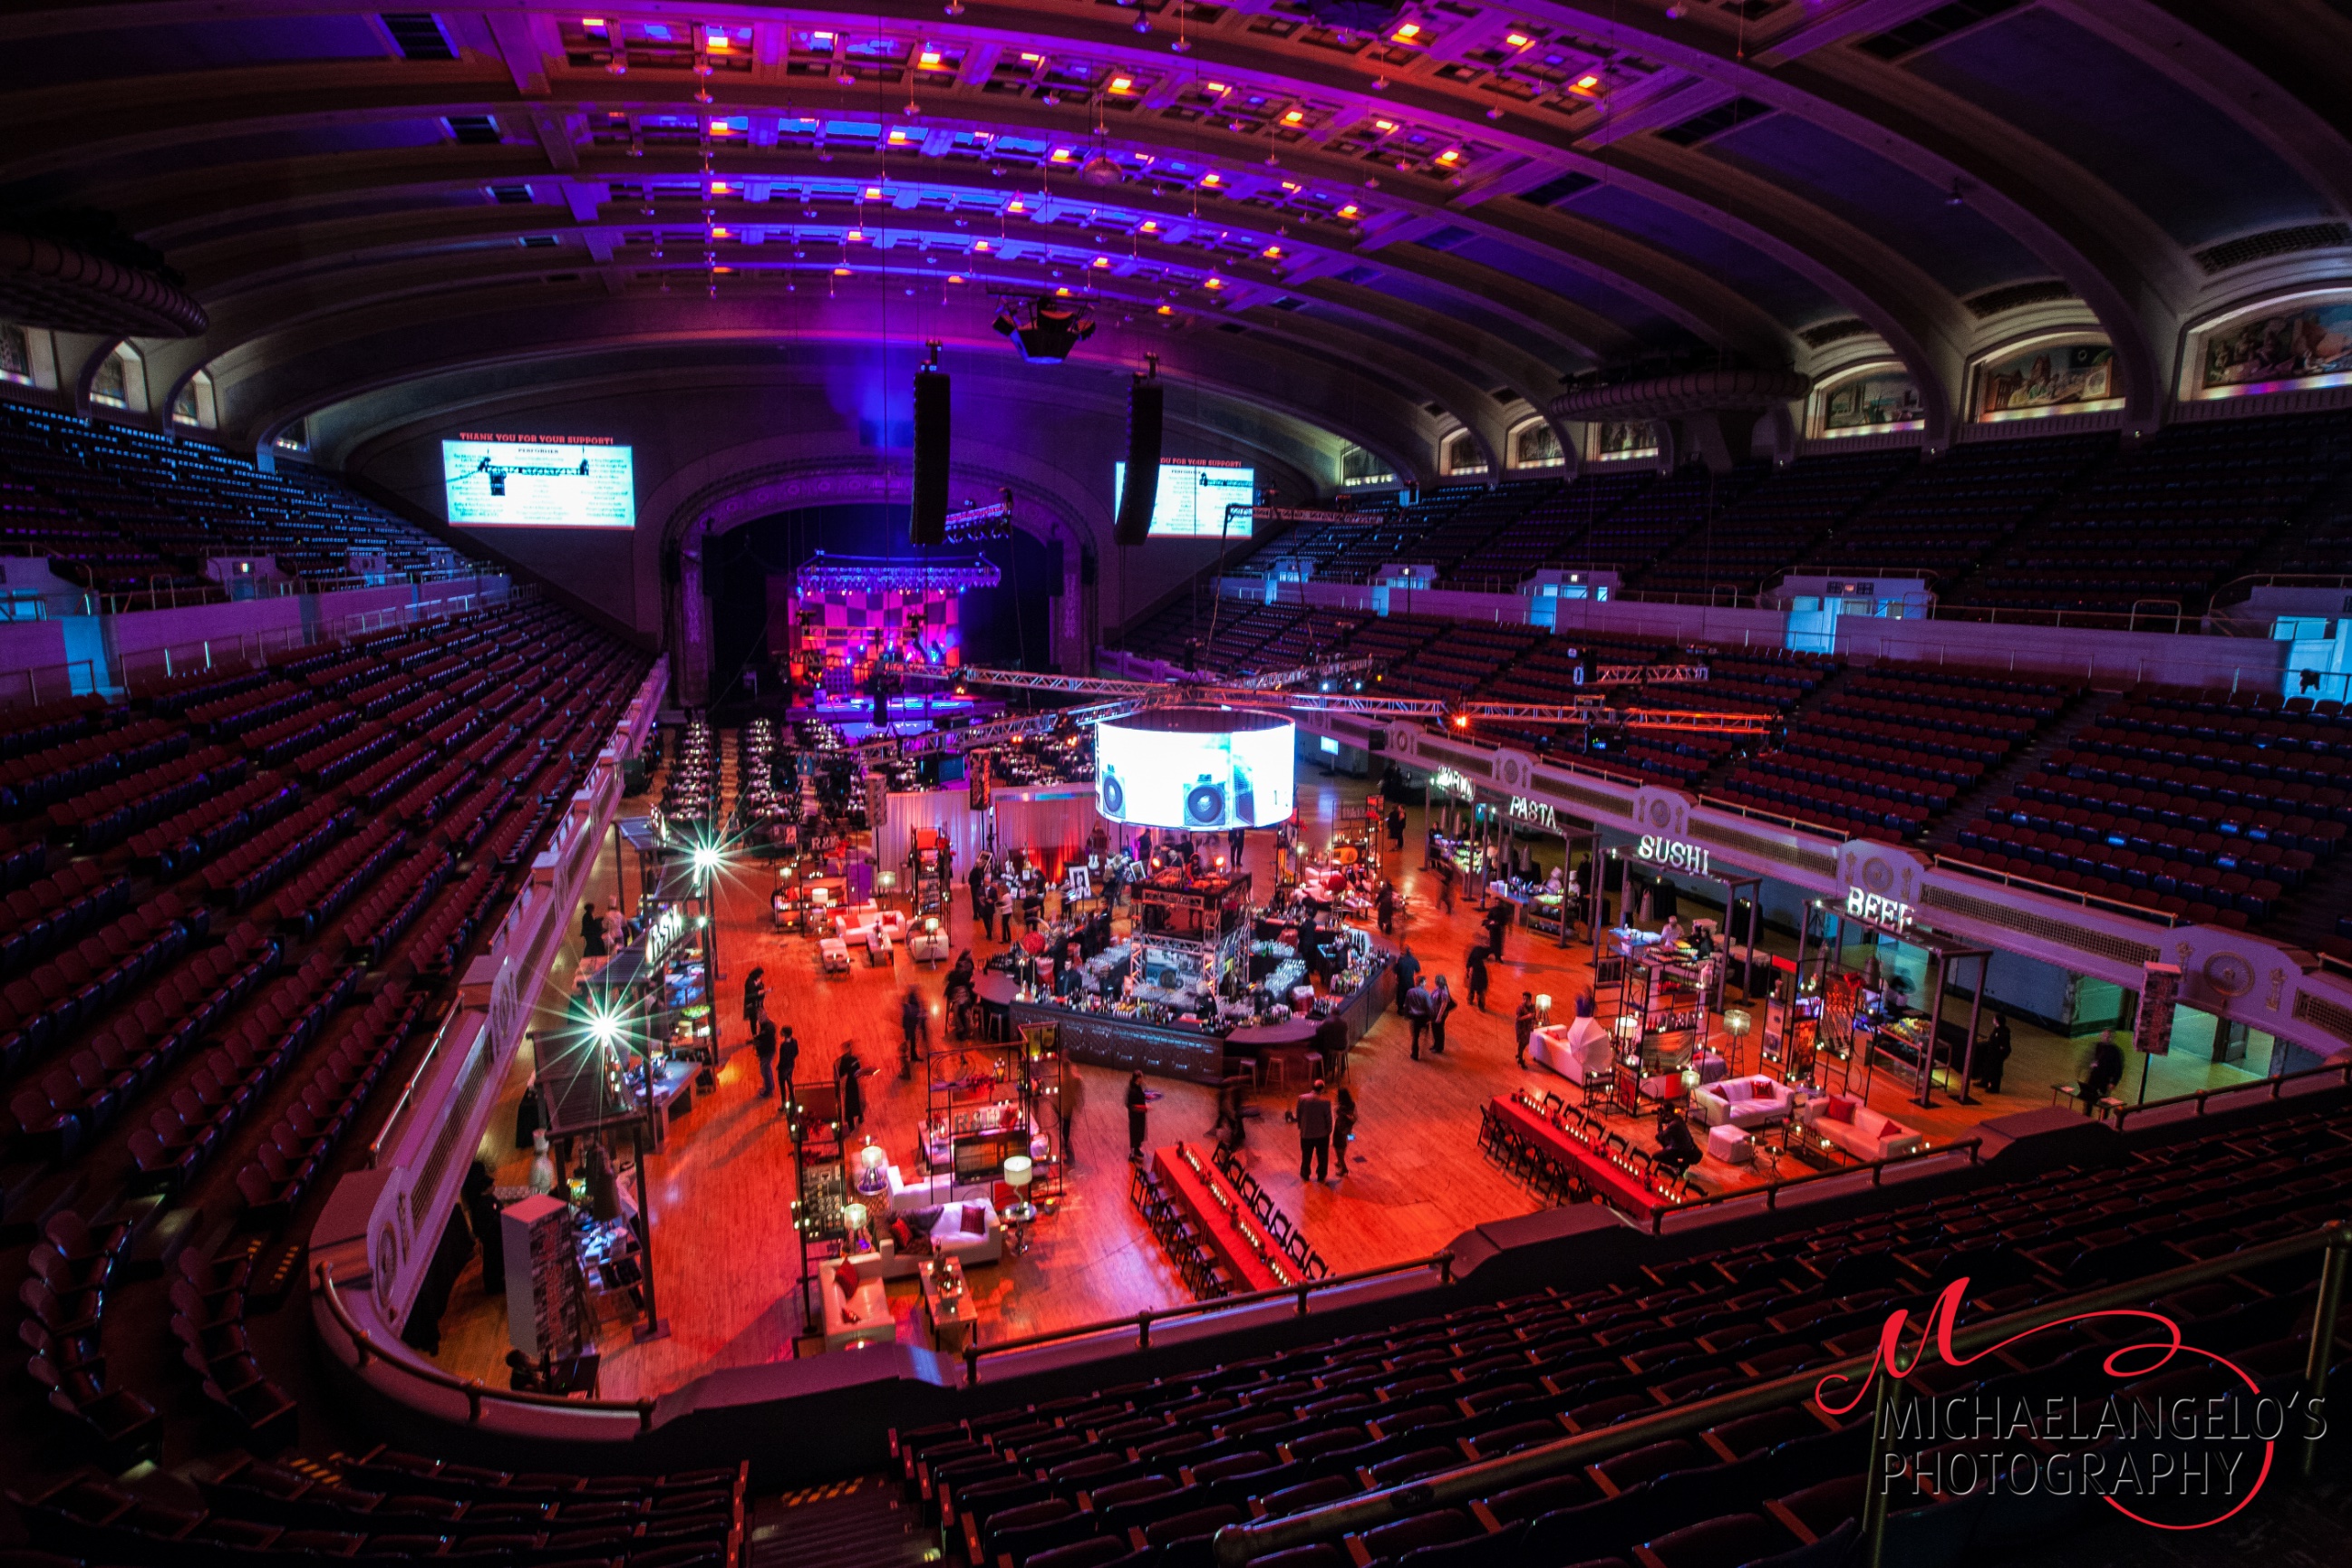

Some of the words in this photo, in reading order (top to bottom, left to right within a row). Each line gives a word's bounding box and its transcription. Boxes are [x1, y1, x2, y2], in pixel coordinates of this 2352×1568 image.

[460, 432, 493, 440] THANK
[495, 433, 516, 442] YOU
[518, 434, 537, 443] FOR
[539, 435, 565, 444] YOUR
[567, 436, 614, 445] SUPPORT!
[1208, 460, 1242, 468] SUPPORT!
[1509, 795, 1557, 831] PASTA
[1639, 834, 1709, 876] SUSHI
[1847, 886, 1914, 934] BEEF
